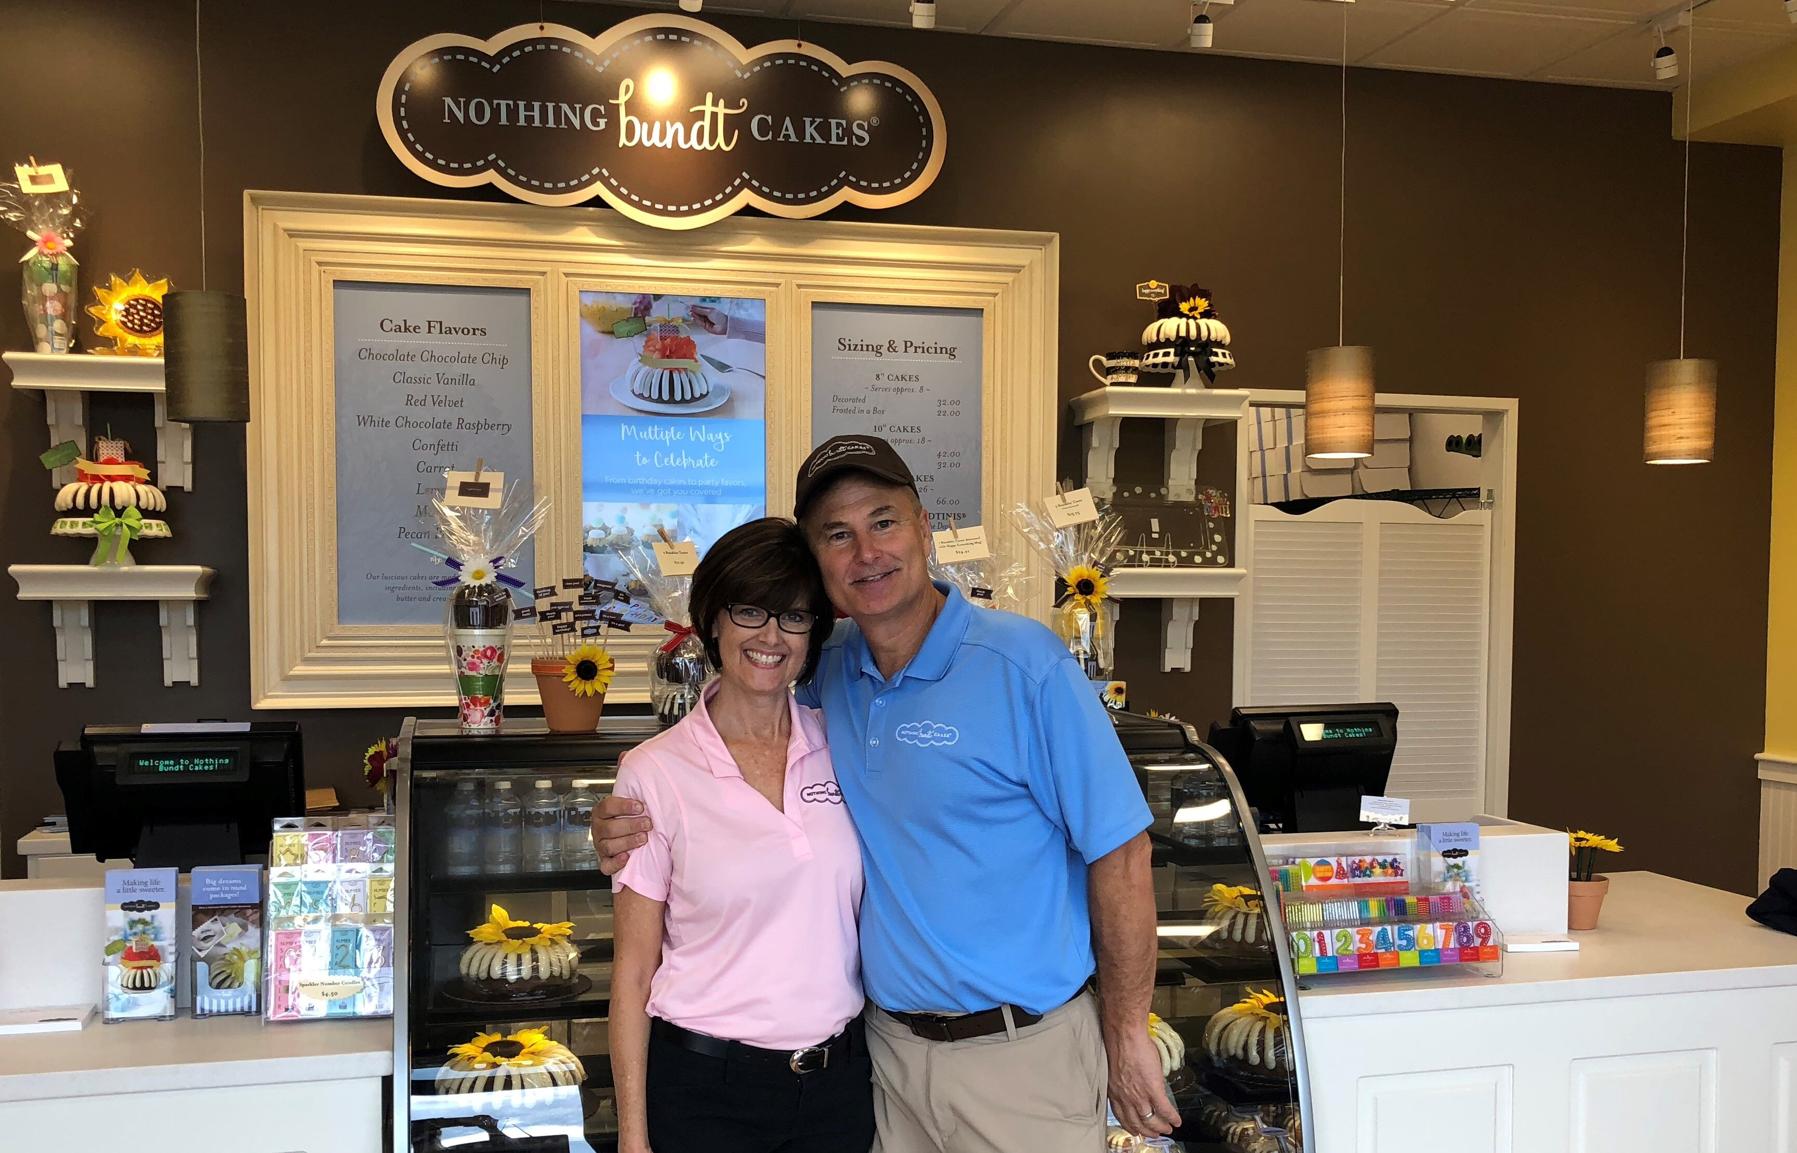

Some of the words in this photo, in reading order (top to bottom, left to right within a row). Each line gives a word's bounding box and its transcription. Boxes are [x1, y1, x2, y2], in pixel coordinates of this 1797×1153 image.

[442, 96, 608, 132] NOTHING
[608, 78, 748, 151] bundt
[379, 318, 422, 334] Cake
[426, 320, 487, 337] Flavors
[837, 337, 884, 357] Sizing
[886, 339, 898, 353] &
[902, 340, 957, 360] Pricing
[358, 348, 416, 362] Chocolate
[420, 349, 477, 364] Chocolate
[481, 352, 509, 369] Chip
[392, 371, 432, 385] Classic
[436, 372, 476, 386] Vanilla
[887, 374, 920, 382] CAKES
[405, 394, 427, 407] Red
[431, 394, 464, 408] Velvet
[832, 395, 866, 404] Decorated
[937, 399, 961, 407] 32.00
[831, 406, 856, 415] Frosted
[872, 407, 885, 415] Box
[356, 414, 391, 429] White
[395, 416, 452, 431] Chocolate
[456, 418, 512, 435] Raspberry
[889, 425, 922, 433] CAKES
[621, 423, 685, 446] Multiple
[689, 425, 732, 451] Ways
[412, 438, 459, 456] Confetti
[634, 451, 650, 465] to
[654, 450, 719, 469] Celebrate
[937, 451, 961, 459] 42.00
[937, 461, 961, 470] 32.00
[397, 526, 430, 541] Pecan
[366, 572, 380, 580] Our
[139, 759, 174, 767] Welcome
[179, 758, 190, 766] to
[194, 757, 229, 765] Nothing
[158, 764, 184, 772] Bundt
[188, 763, 218, 771] Cakes!
[122, 879, 148, 887] Making
[149, 878, 161, 886] life
[205, 878, 216, 886] Big
[1316, 931, 1328, 956] 1
[1335, 929, 1353, 955] 2
[1356, 928, 1374, 954] 3
[1375, 927, 1394, 951] 4
[1397, 924, 1415, 951] 5
[1417, 923, 1434, 949] 6
[1439, 923, 1453, 948] 7
[1455, 921, 1474, 948] 8
[1474, 921, 1492, 946] 9
